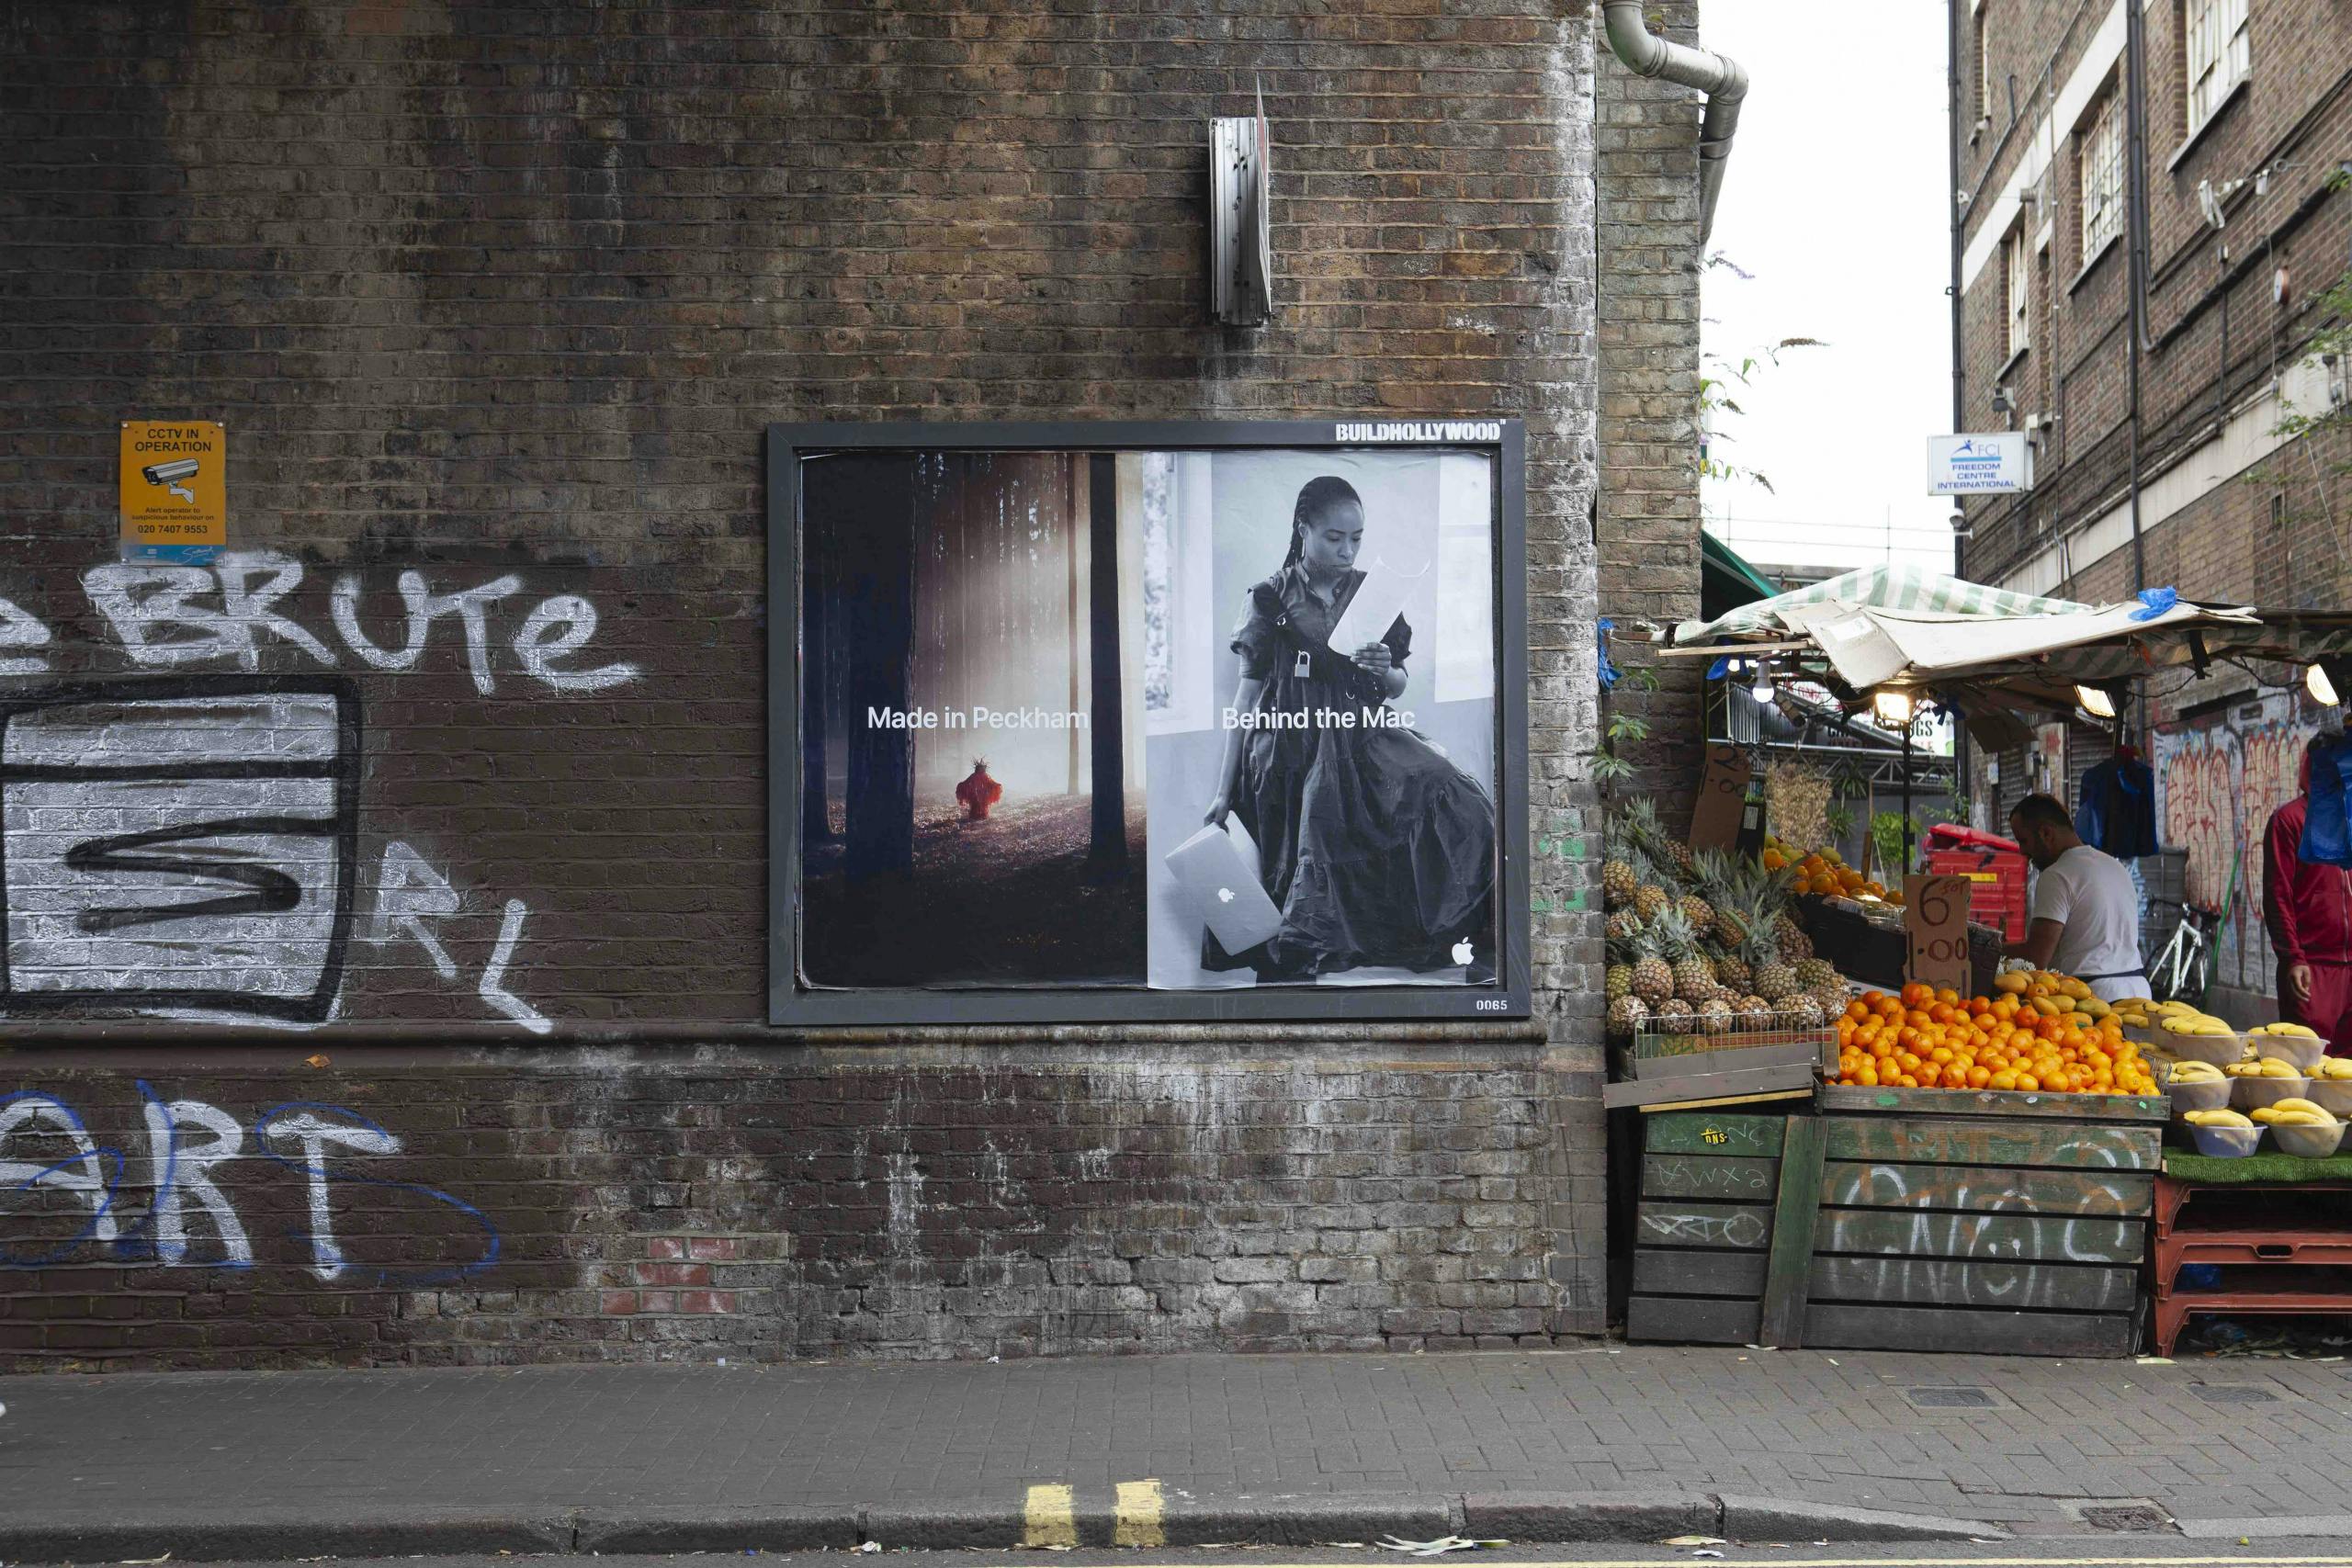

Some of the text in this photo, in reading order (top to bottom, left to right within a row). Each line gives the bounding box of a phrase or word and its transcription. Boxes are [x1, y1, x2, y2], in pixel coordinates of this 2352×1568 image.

[148, 429, 199, 439] CCTV IN
[135, 441, 212, 452] OPERATION
[1977, 444, 2000, 457] FCI
[1938, 480, 2016, 490] INTERNATIONAL
[163, 507, 191, 515] operator
[138, 525, 208, 534] 020 7407 9553
[867, 705, 1090, 729] Made in Peckham
[1222, 705, 1416, 729] Behind the Mac
[1918, 876, 1950, 926] 6
[1476, 999, 1508, 1010] 0065
